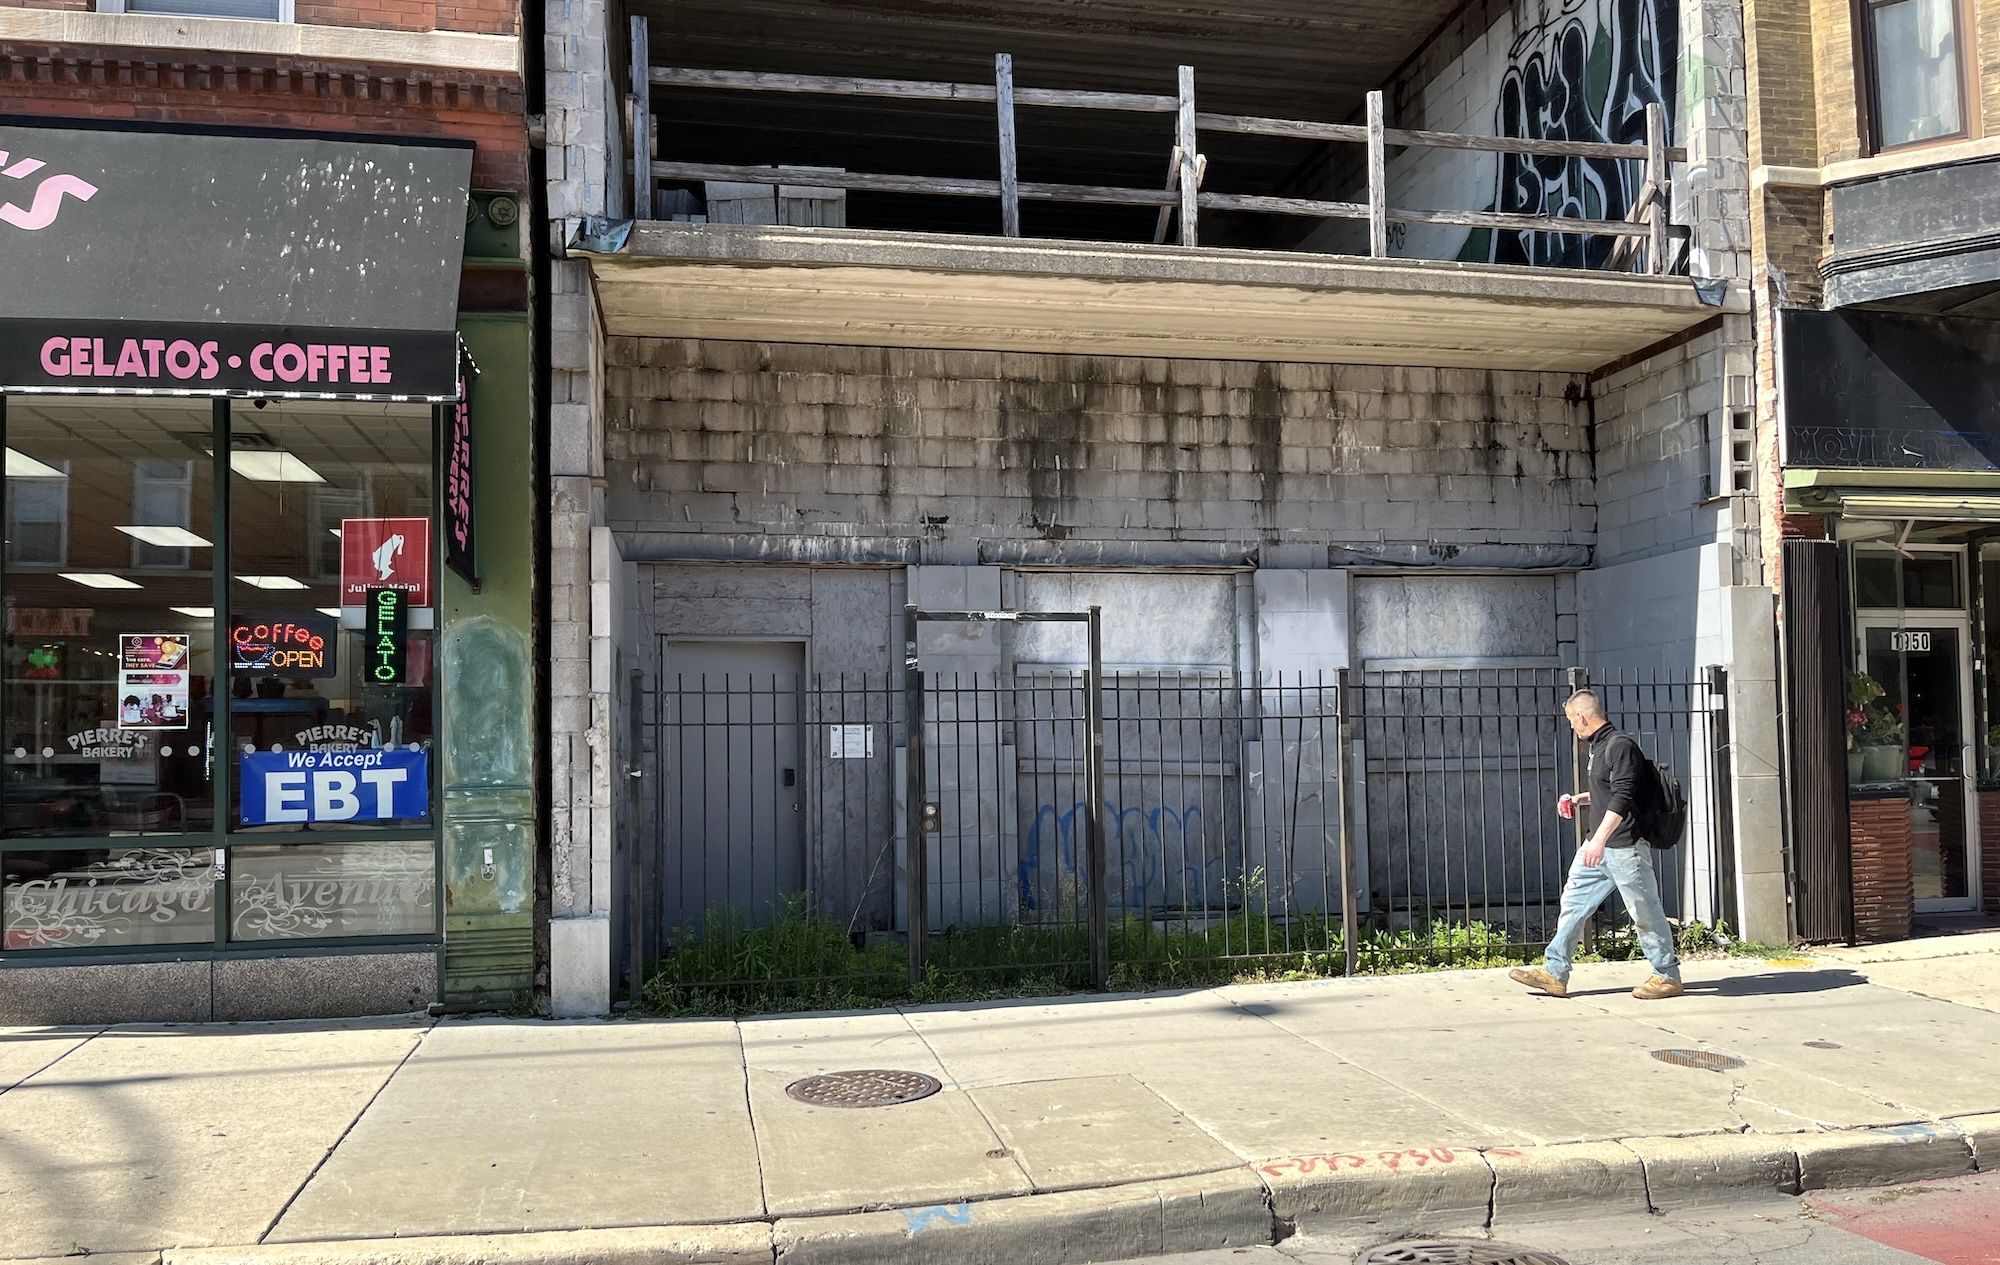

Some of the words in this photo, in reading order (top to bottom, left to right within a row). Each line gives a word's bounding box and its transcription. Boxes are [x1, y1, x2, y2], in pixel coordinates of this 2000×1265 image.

[0, 149, 99, 231] 'S
[40, 337, 219, 380] GELATOS
[249, 342, 393, 384] COFFEE
[375, 591, 398, 680] GELATO
[271, 651, 323, 667] OPEN
[67, 728, 148, 750] PIERRE'S
[295, 725, 372, 746] PIERRE'S
[82, 746, 133, 758] BAKERY
[309, 743, 358, 754] BAKERY
[288, 752, 315, 768] We
[319, 752, 383, 769] Accept
[265, 768, 408, 823] EBT
[14, 877, 211, 922] Chicago
